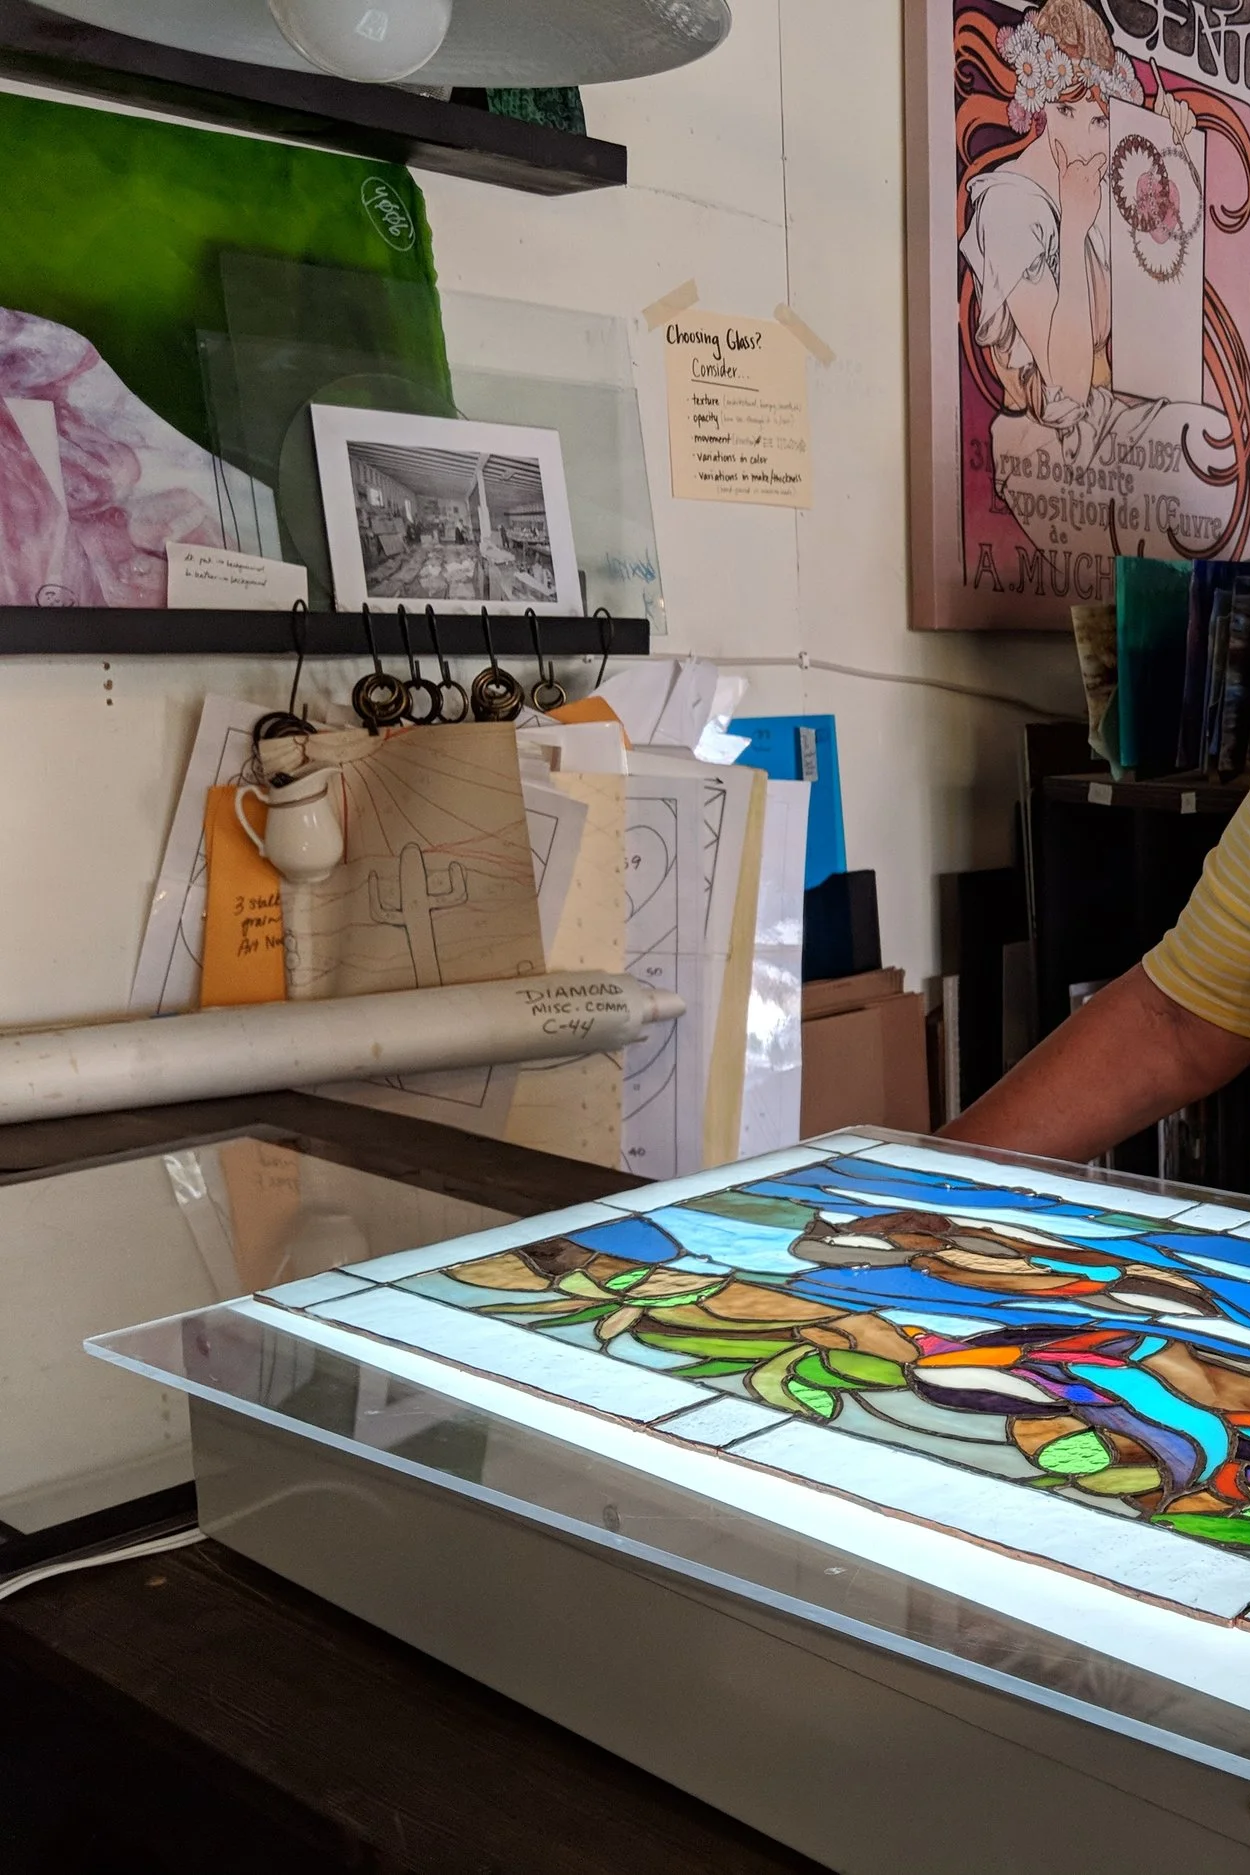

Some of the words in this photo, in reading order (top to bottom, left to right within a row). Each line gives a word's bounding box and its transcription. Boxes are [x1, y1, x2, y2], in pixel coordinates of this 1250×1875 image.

[666, 323, 722, 361] Choosing
[726, 327, 762, 351] Glass?
[692, 393, 720, 406] texture
[692, 412, 720, 431] opacity
[694, 432, 731, 445] movement
[696, 450, 737, 463] variations
[740, 452, 748, 463] in
[749, 453, 768, 465] color
[698, 469, 738, 481] variations
[1035, 448, 1136, 496] Bonaparte
[988, 476, 1111, 532] Exposition
[1116, 499, 1140, 530] de
[1049, 524, 1069, 545] de
[973, 542, 1118, 601] A.MUCH
[516, 983, 624, 1004] DIAMOND
